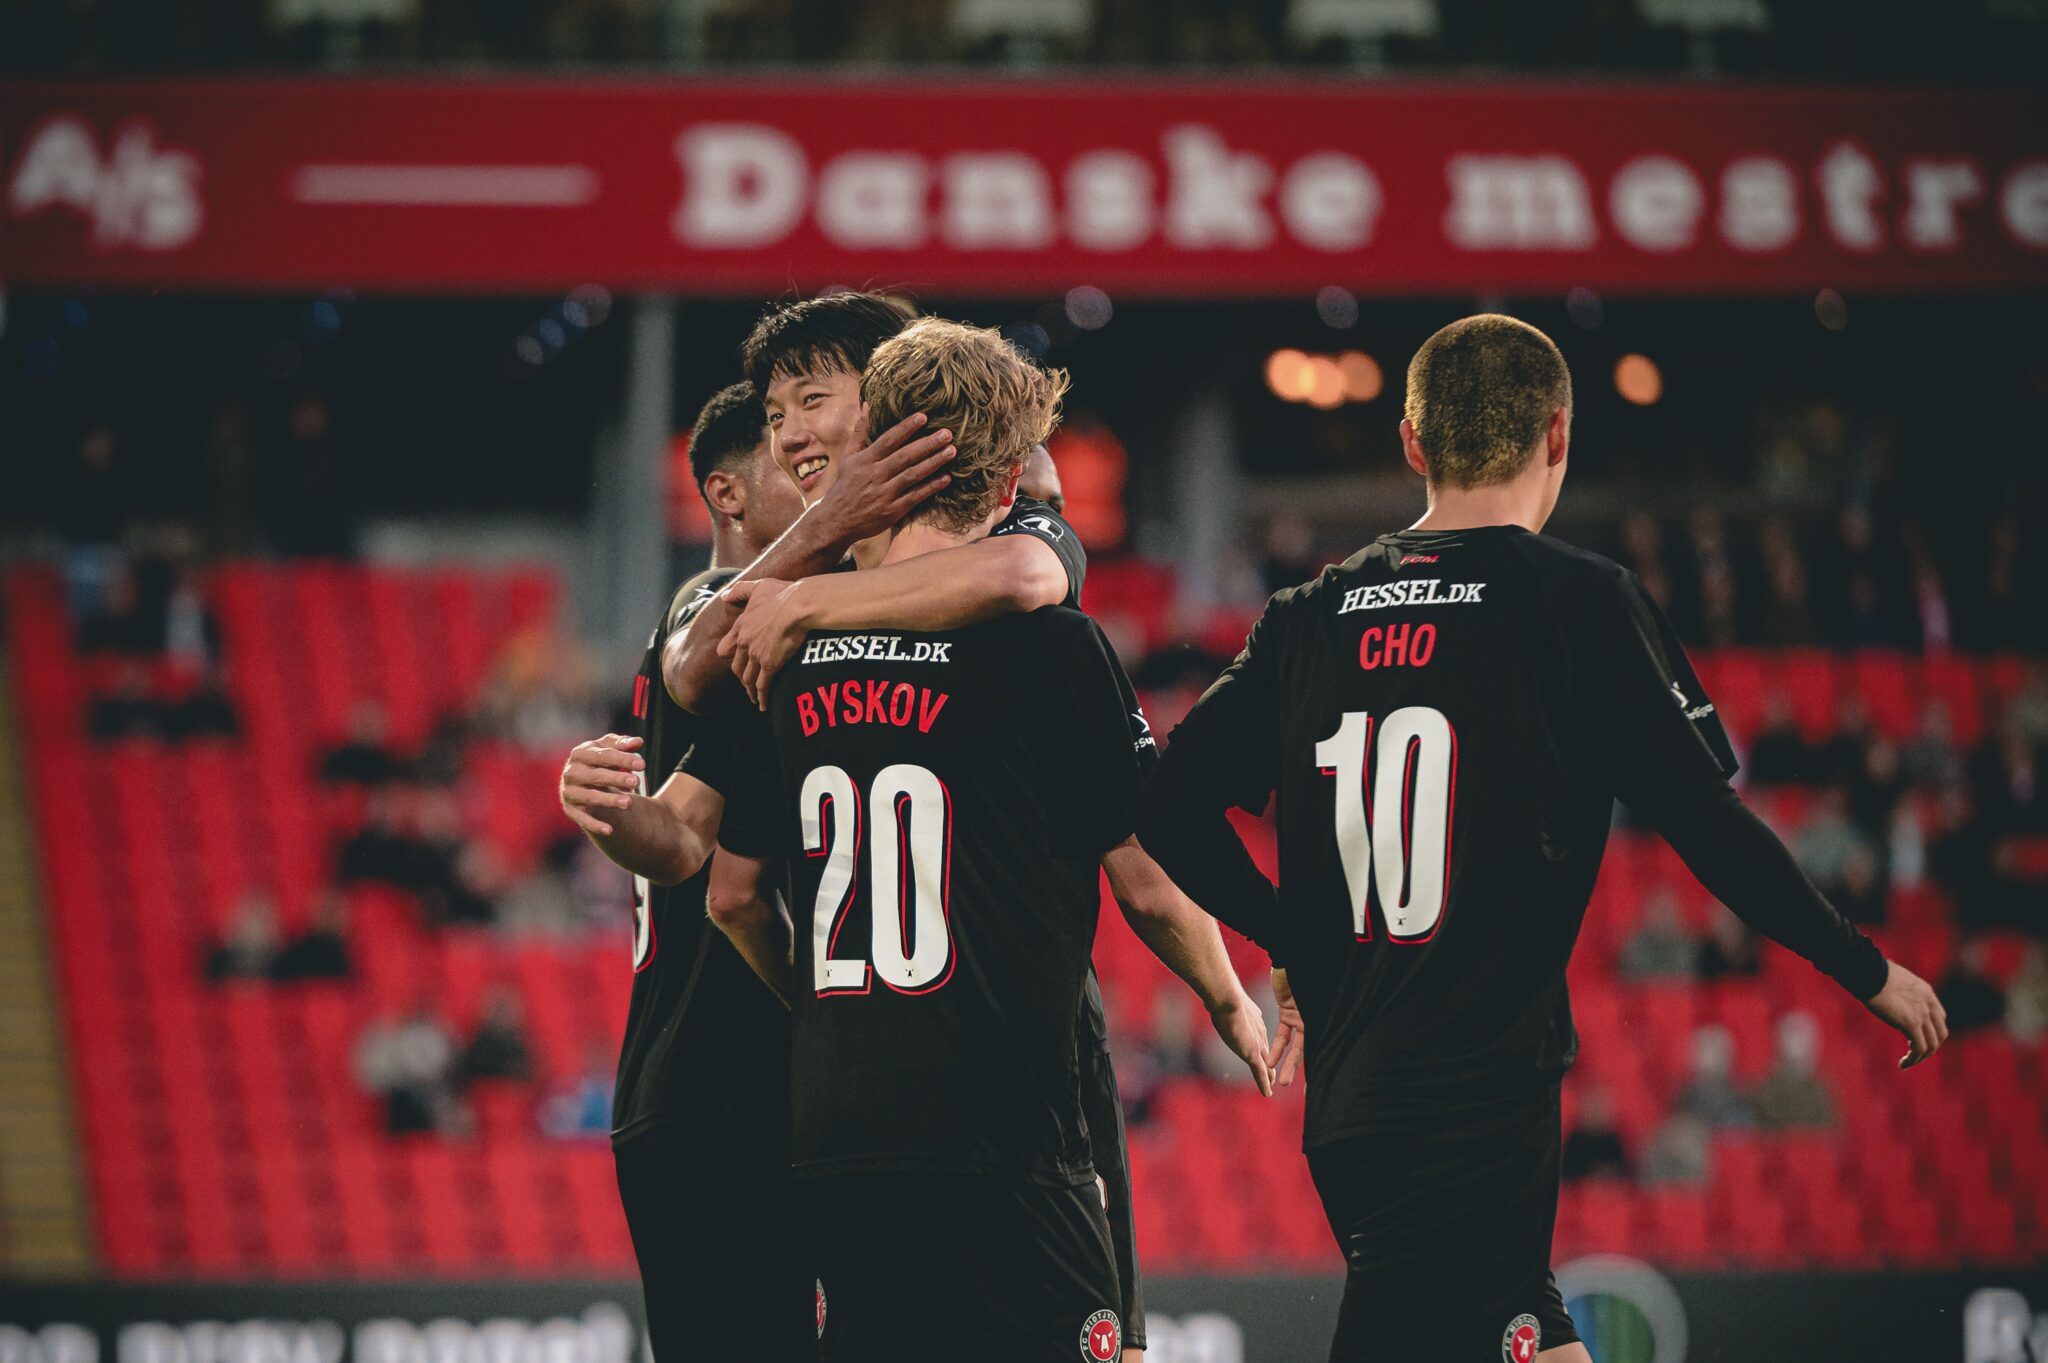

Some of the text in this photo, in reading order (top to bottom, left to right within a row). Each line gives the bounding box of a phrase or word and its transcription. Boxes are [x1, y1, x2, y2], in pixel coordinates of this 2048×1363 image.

[674, 121, 1382, 250] Danske
[1337, 579, 1487, 615] HESSEL.DK
[801, 635, 952, 665] HESSEL.DK
[1359, 623, 1437, 670] CHO
[796, 679, 949, 737] BYSKOV
[1315, 705, 1458, 945] 10
[800, 763, 957, 999] 20
